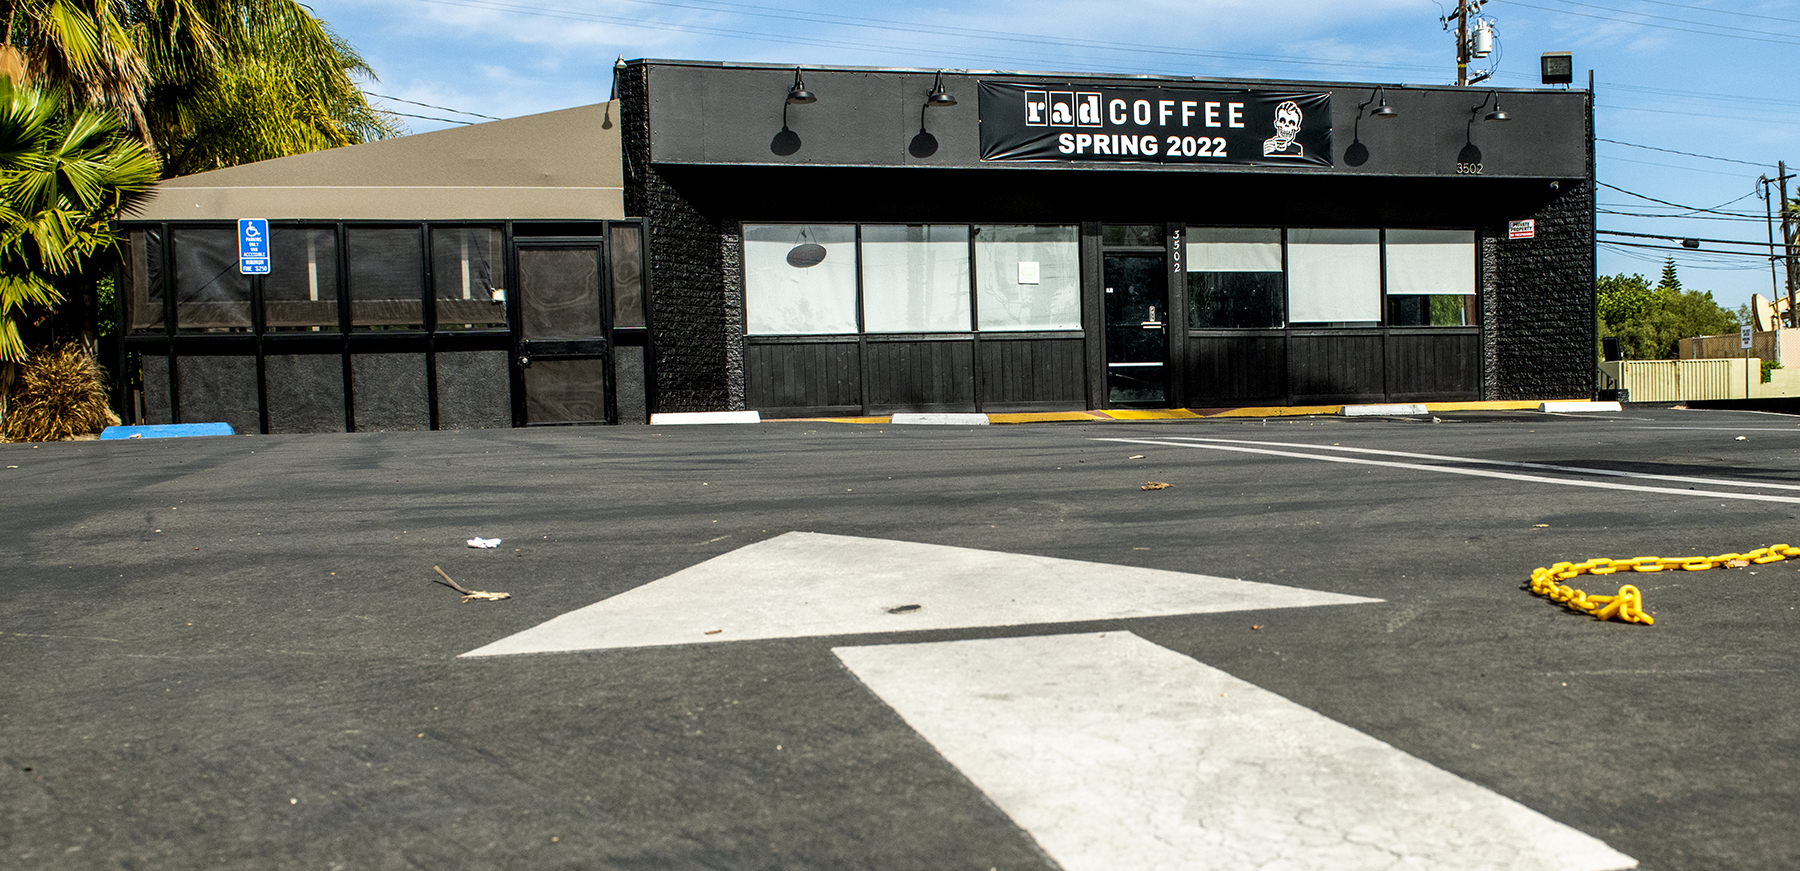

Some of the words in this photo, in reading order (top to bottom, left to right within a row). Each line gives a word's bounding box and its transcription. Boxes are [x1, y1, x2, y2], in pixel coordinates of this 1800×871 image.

[1027, 95, 1101, 125] rad
[1109, 99, 1245, 128] COFFEE
[1058, 132, 1158, 156] SPRING
[1166, 136, 1228, 158] 2022
[1456, 162, 1484, 174] 3502
[1172, 230, 1180, 273] 3502
